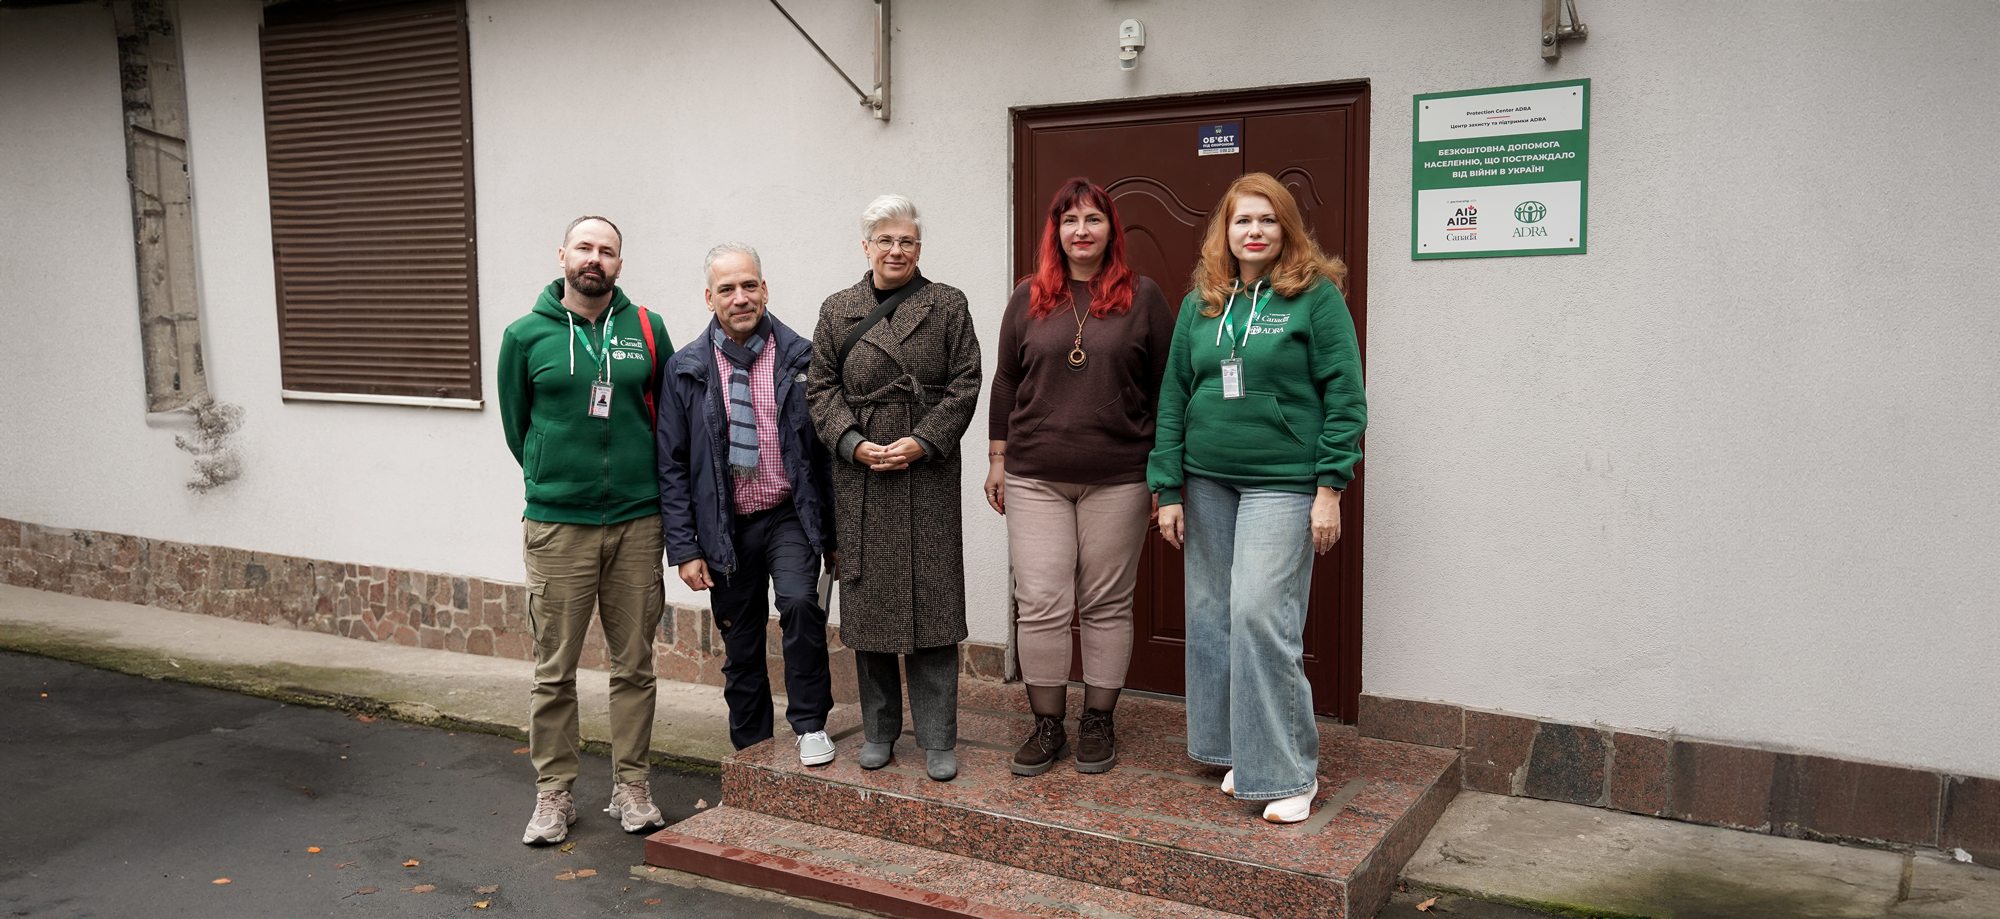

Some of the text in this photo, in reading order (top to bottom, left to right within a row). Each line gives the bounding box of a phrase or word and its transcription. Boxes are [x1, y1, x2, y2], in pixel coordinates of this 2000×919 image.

[1438, 140, 1561, 157] БЕЗКОШТОВНА ДОПОМОГА
[1424, 151, 1576, 169] НАСЕЛЕННЮ, ЩО ПОСТРАЖДАЛО
[1452, 170, 1468, 180] ВІД
[1469, 167, 1498, 177] ВІЙНИ
[1507, 165, 1545, 175] УКРАЇНІ
[1454, 205, 1478, 217] AID
[1446, 216, 1478, 227] AIDE
[1446, 232, 1478, 242] Canada
[1512, 225, 1548, 238] ADRA
[1261, 327, 1284, 335] ADRA
